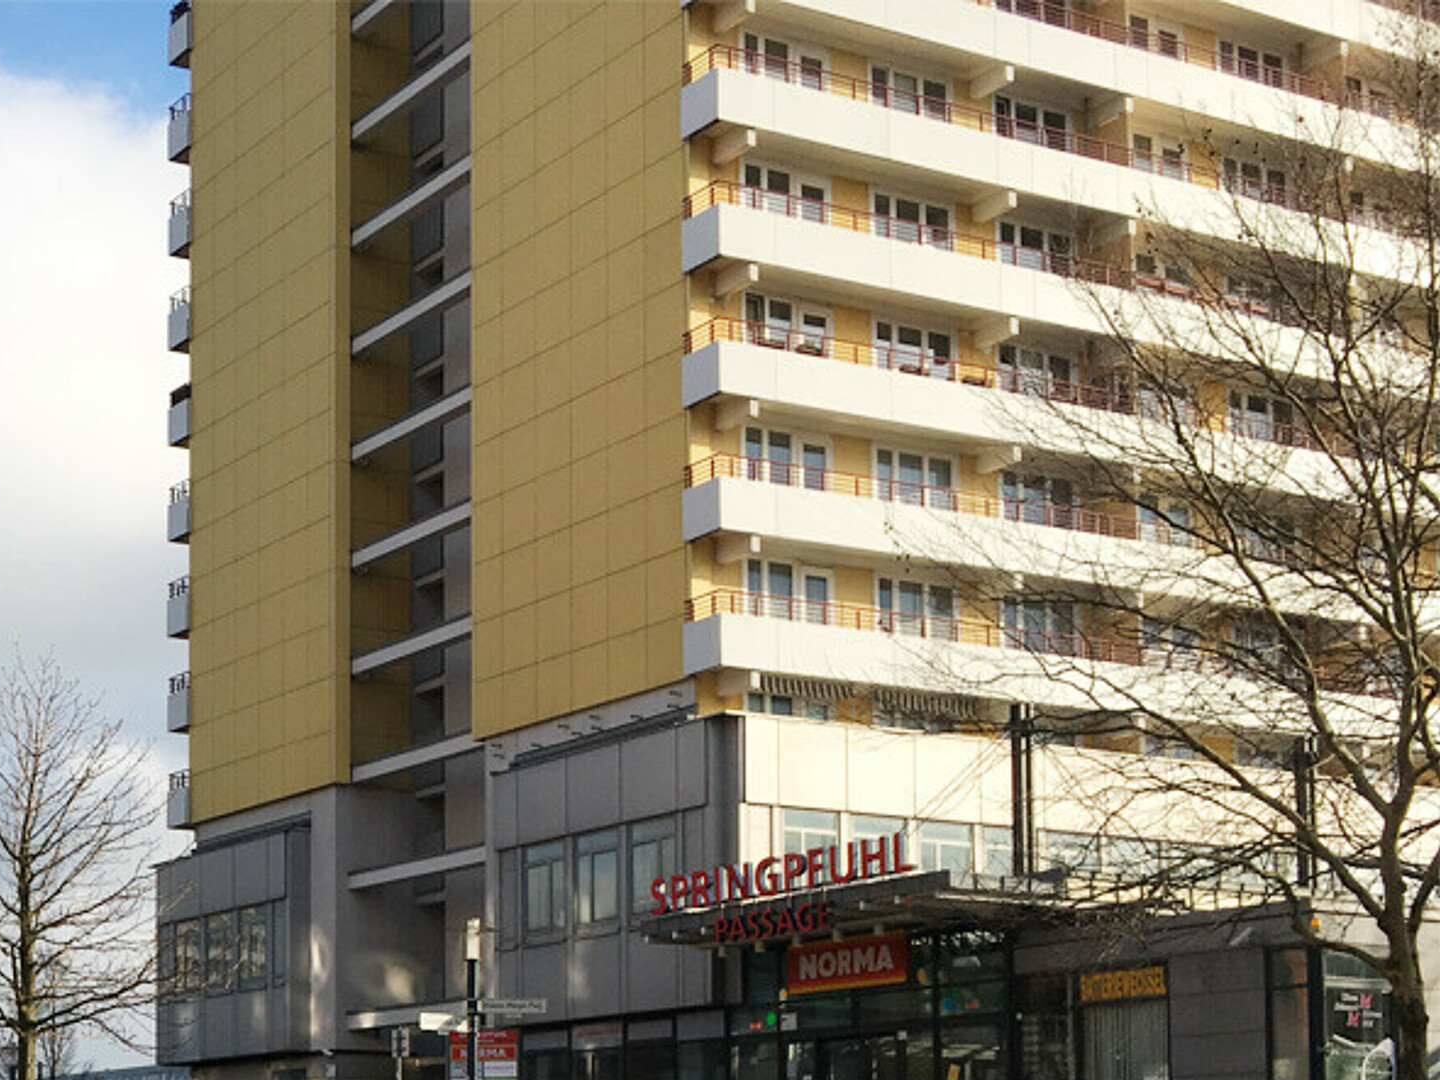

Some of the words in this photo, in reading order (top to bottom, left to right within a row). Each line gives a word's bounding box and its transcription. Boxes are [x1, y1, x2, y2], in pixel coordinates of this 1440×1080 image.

[650, 832, 916, 915] SPRINGPFUHL
[715, 900, 832, 943] PASSAGE
[798, 945, 894, 981] NORMA
